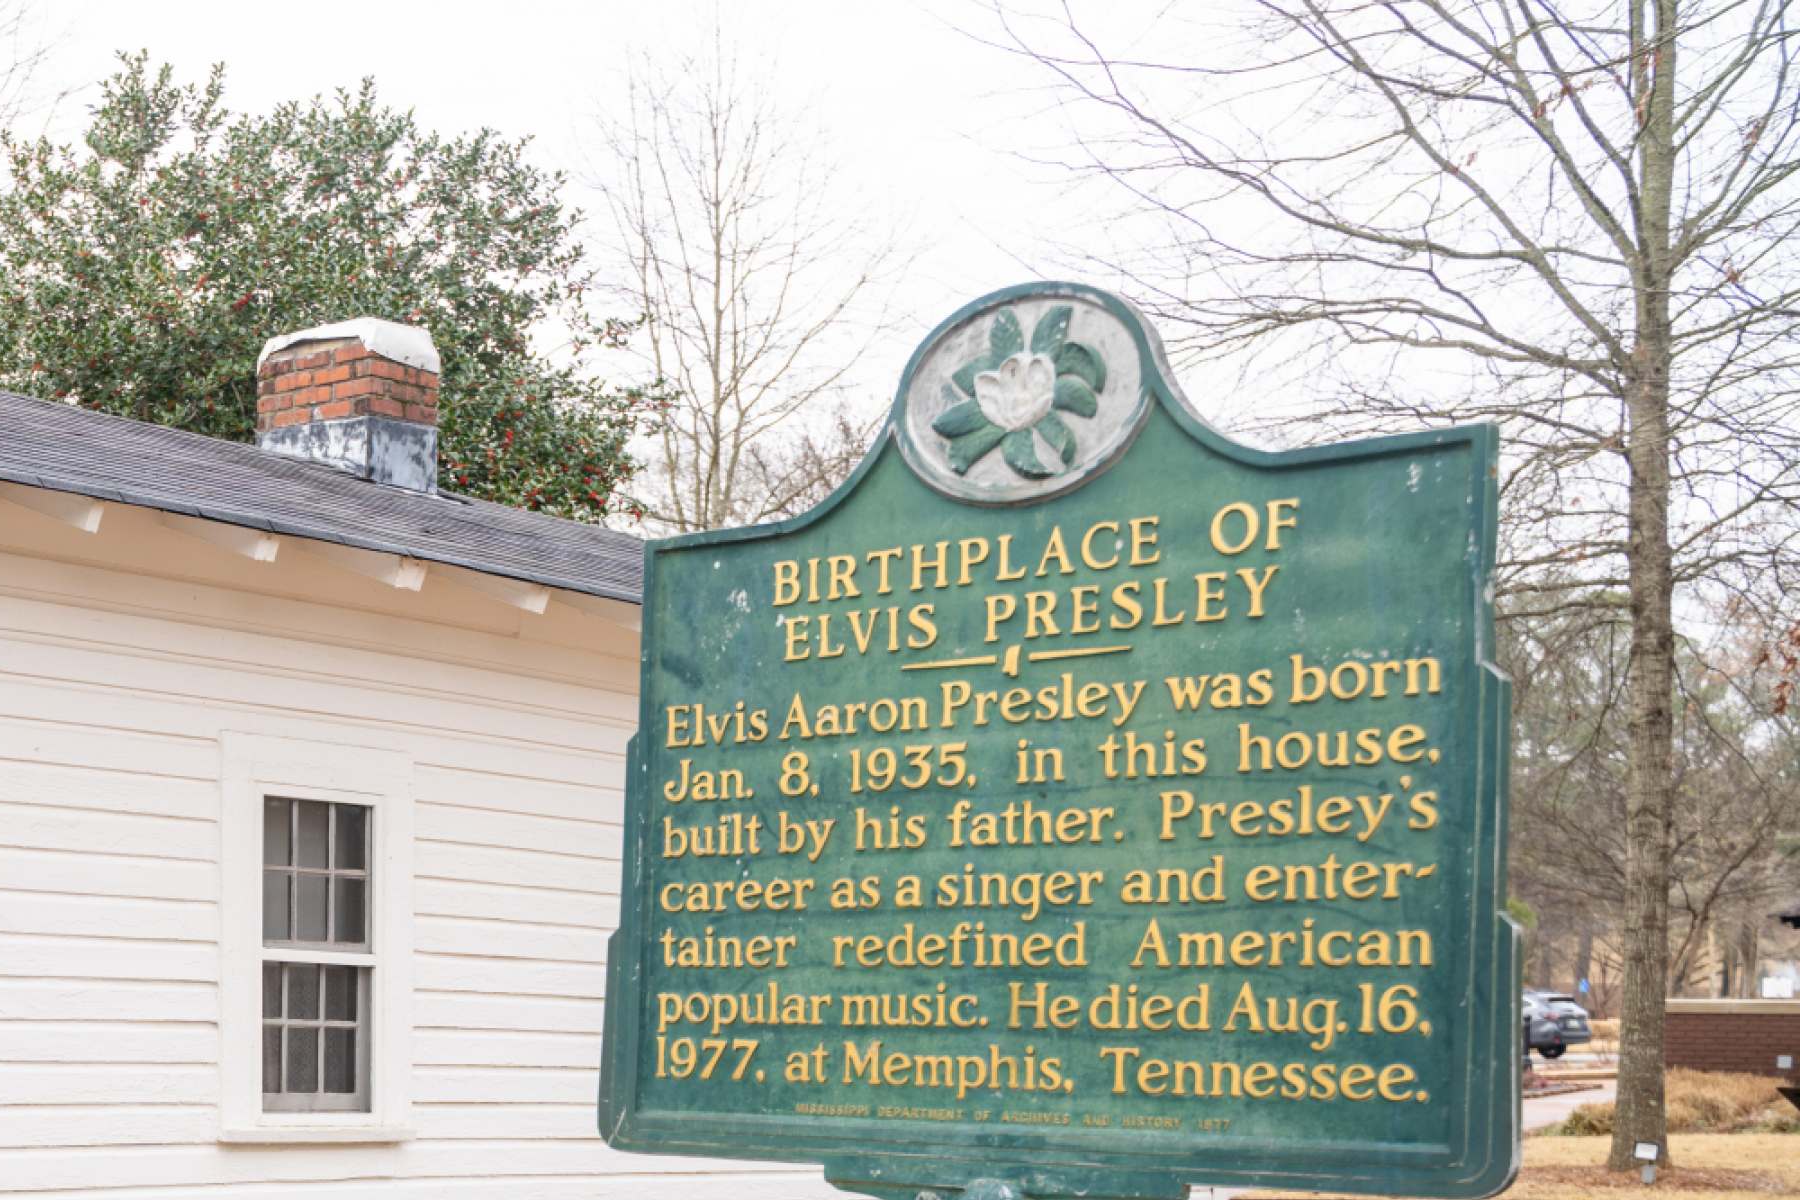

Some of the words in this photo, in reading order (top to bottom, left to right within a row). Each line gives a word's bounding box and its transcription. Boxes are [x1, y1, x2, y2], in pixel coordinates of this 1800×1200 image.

[773, 515, 1161, 606] BIRTHPLACE
[1209, 498, 1299, 555] OF
[784, 603, 937, 662] ELVIS
[984, 564, 1278, 642] PRESLEY
[666, 704, 769, 748] Elvis
[778, 693, 929, 740] Aaron
[940, 671, 1143, 728] Presley
[1164, 669, 1274, 711] was
[1288, 654, 1441, 703] born
[663, 758, 754, 802] Jan.
[778, 751, 820, 797] 8,
[850, 741, 977, 793] 1935,
[1017, 738, 1065, 783] in
[1103, 730, 1208, 779] this
[1237, 722, 1440, 774] house,
[663, 813, 761, 858] built
[778, 810, 836, 862] by
[855, 805, 927, 851] his
[947, 799, 1124, 847] father.
[1159, 775, 1440, 842] Presley's
[659, 878, 815, 913] career
[829, 875, 881, 909] as
[894, 875, 922, 909] a
[936, 863, 1104, 922] singer
[1120, 854, 1226, 904] and
[1243, 853, 1437, 902] enter-
[660, 927, 797, 968] tainer
[832, 921, 1088, 968] redefined
[1131, 918, 1434, 968] American
[657, 981, 833, 1035] popular
[841, 982, 989, 1027] music.
[1009, 981, 1081, 1029] He
[1088, 983, 1212, 1033] died
[1222, 981, 1348, 1051] Aug.
[1358, 982, 1433, 1036] 16,
[784, 1045, 829, 1084] at
[841, 1040, 1076, 1101] Memphis,
[1098, 1046, 1429, 1102] Tennessee.
[795, 1104, 871, 1118] MISSISSIPPI
[877, 1105, 964, 1121] DEPARTMENT
[974, 1110, 992, 1122] OF
[1001, 1111, 1071, 1127] ARCHIVES
[1083, 1113, 1112, 1128] AND
[1122, 1114, 1183, 1130] HISTORY
